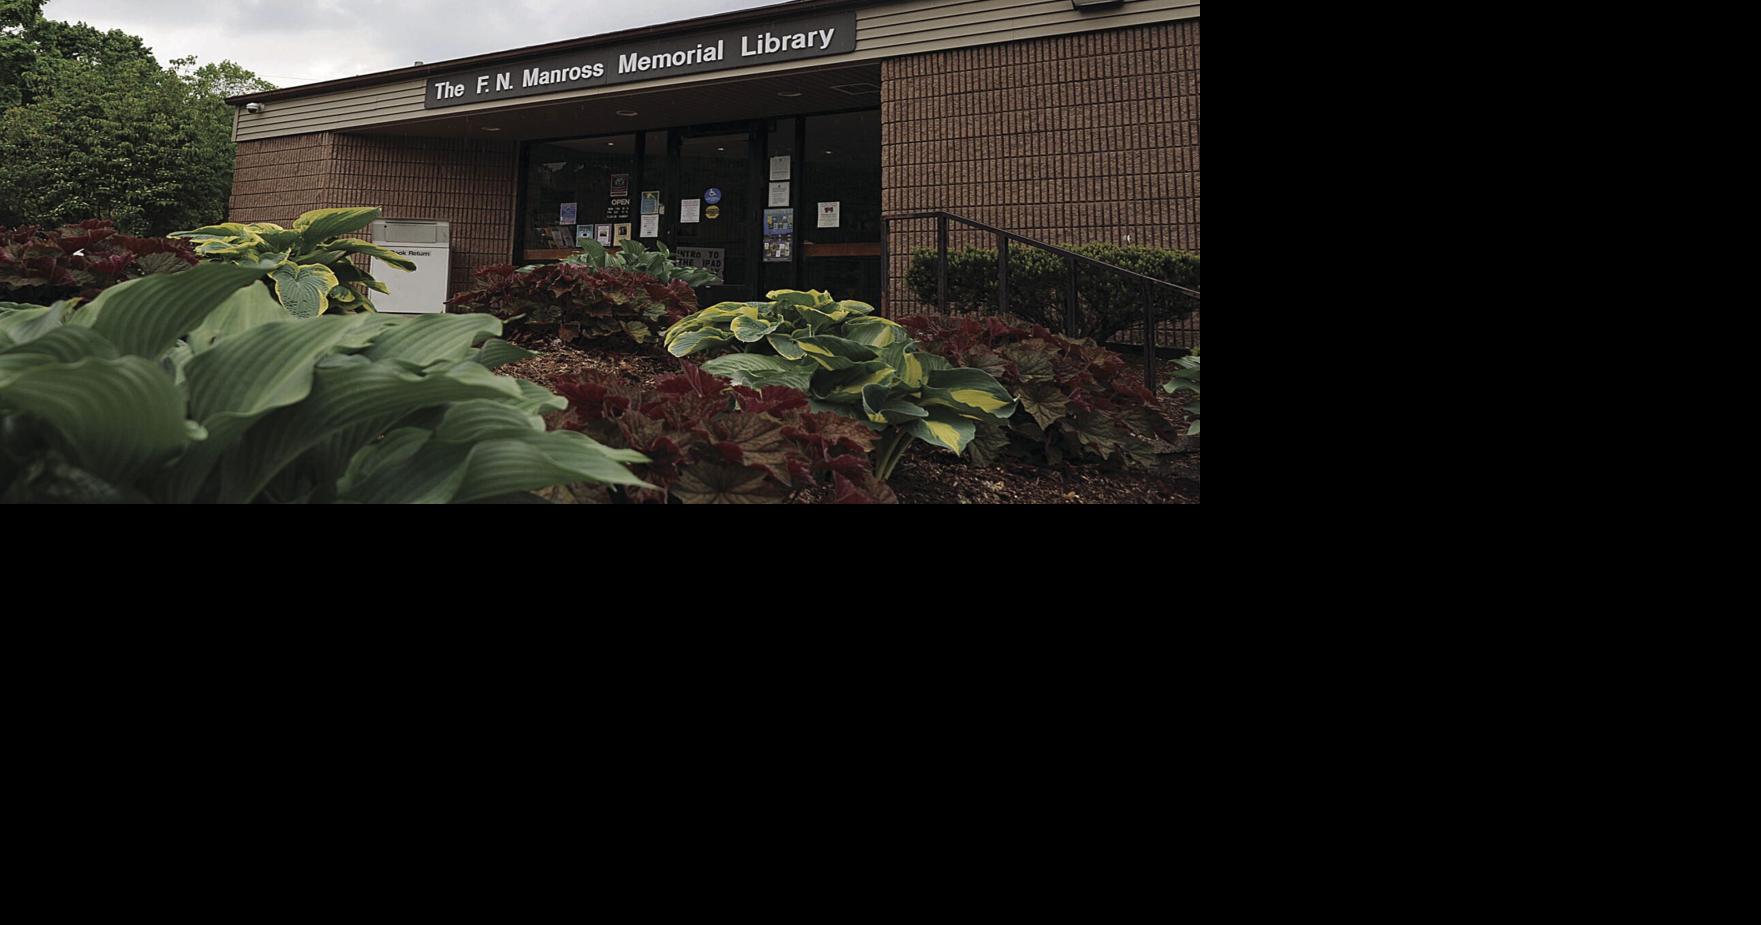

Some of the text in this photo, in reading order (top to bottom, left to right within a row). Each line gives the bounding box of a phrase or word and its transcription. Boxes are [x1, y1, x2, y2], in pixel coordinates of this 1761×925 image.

[434, 28, 835, 100] The F. N. Manross Memorial Library
[708, 250, 719, 259] TO
